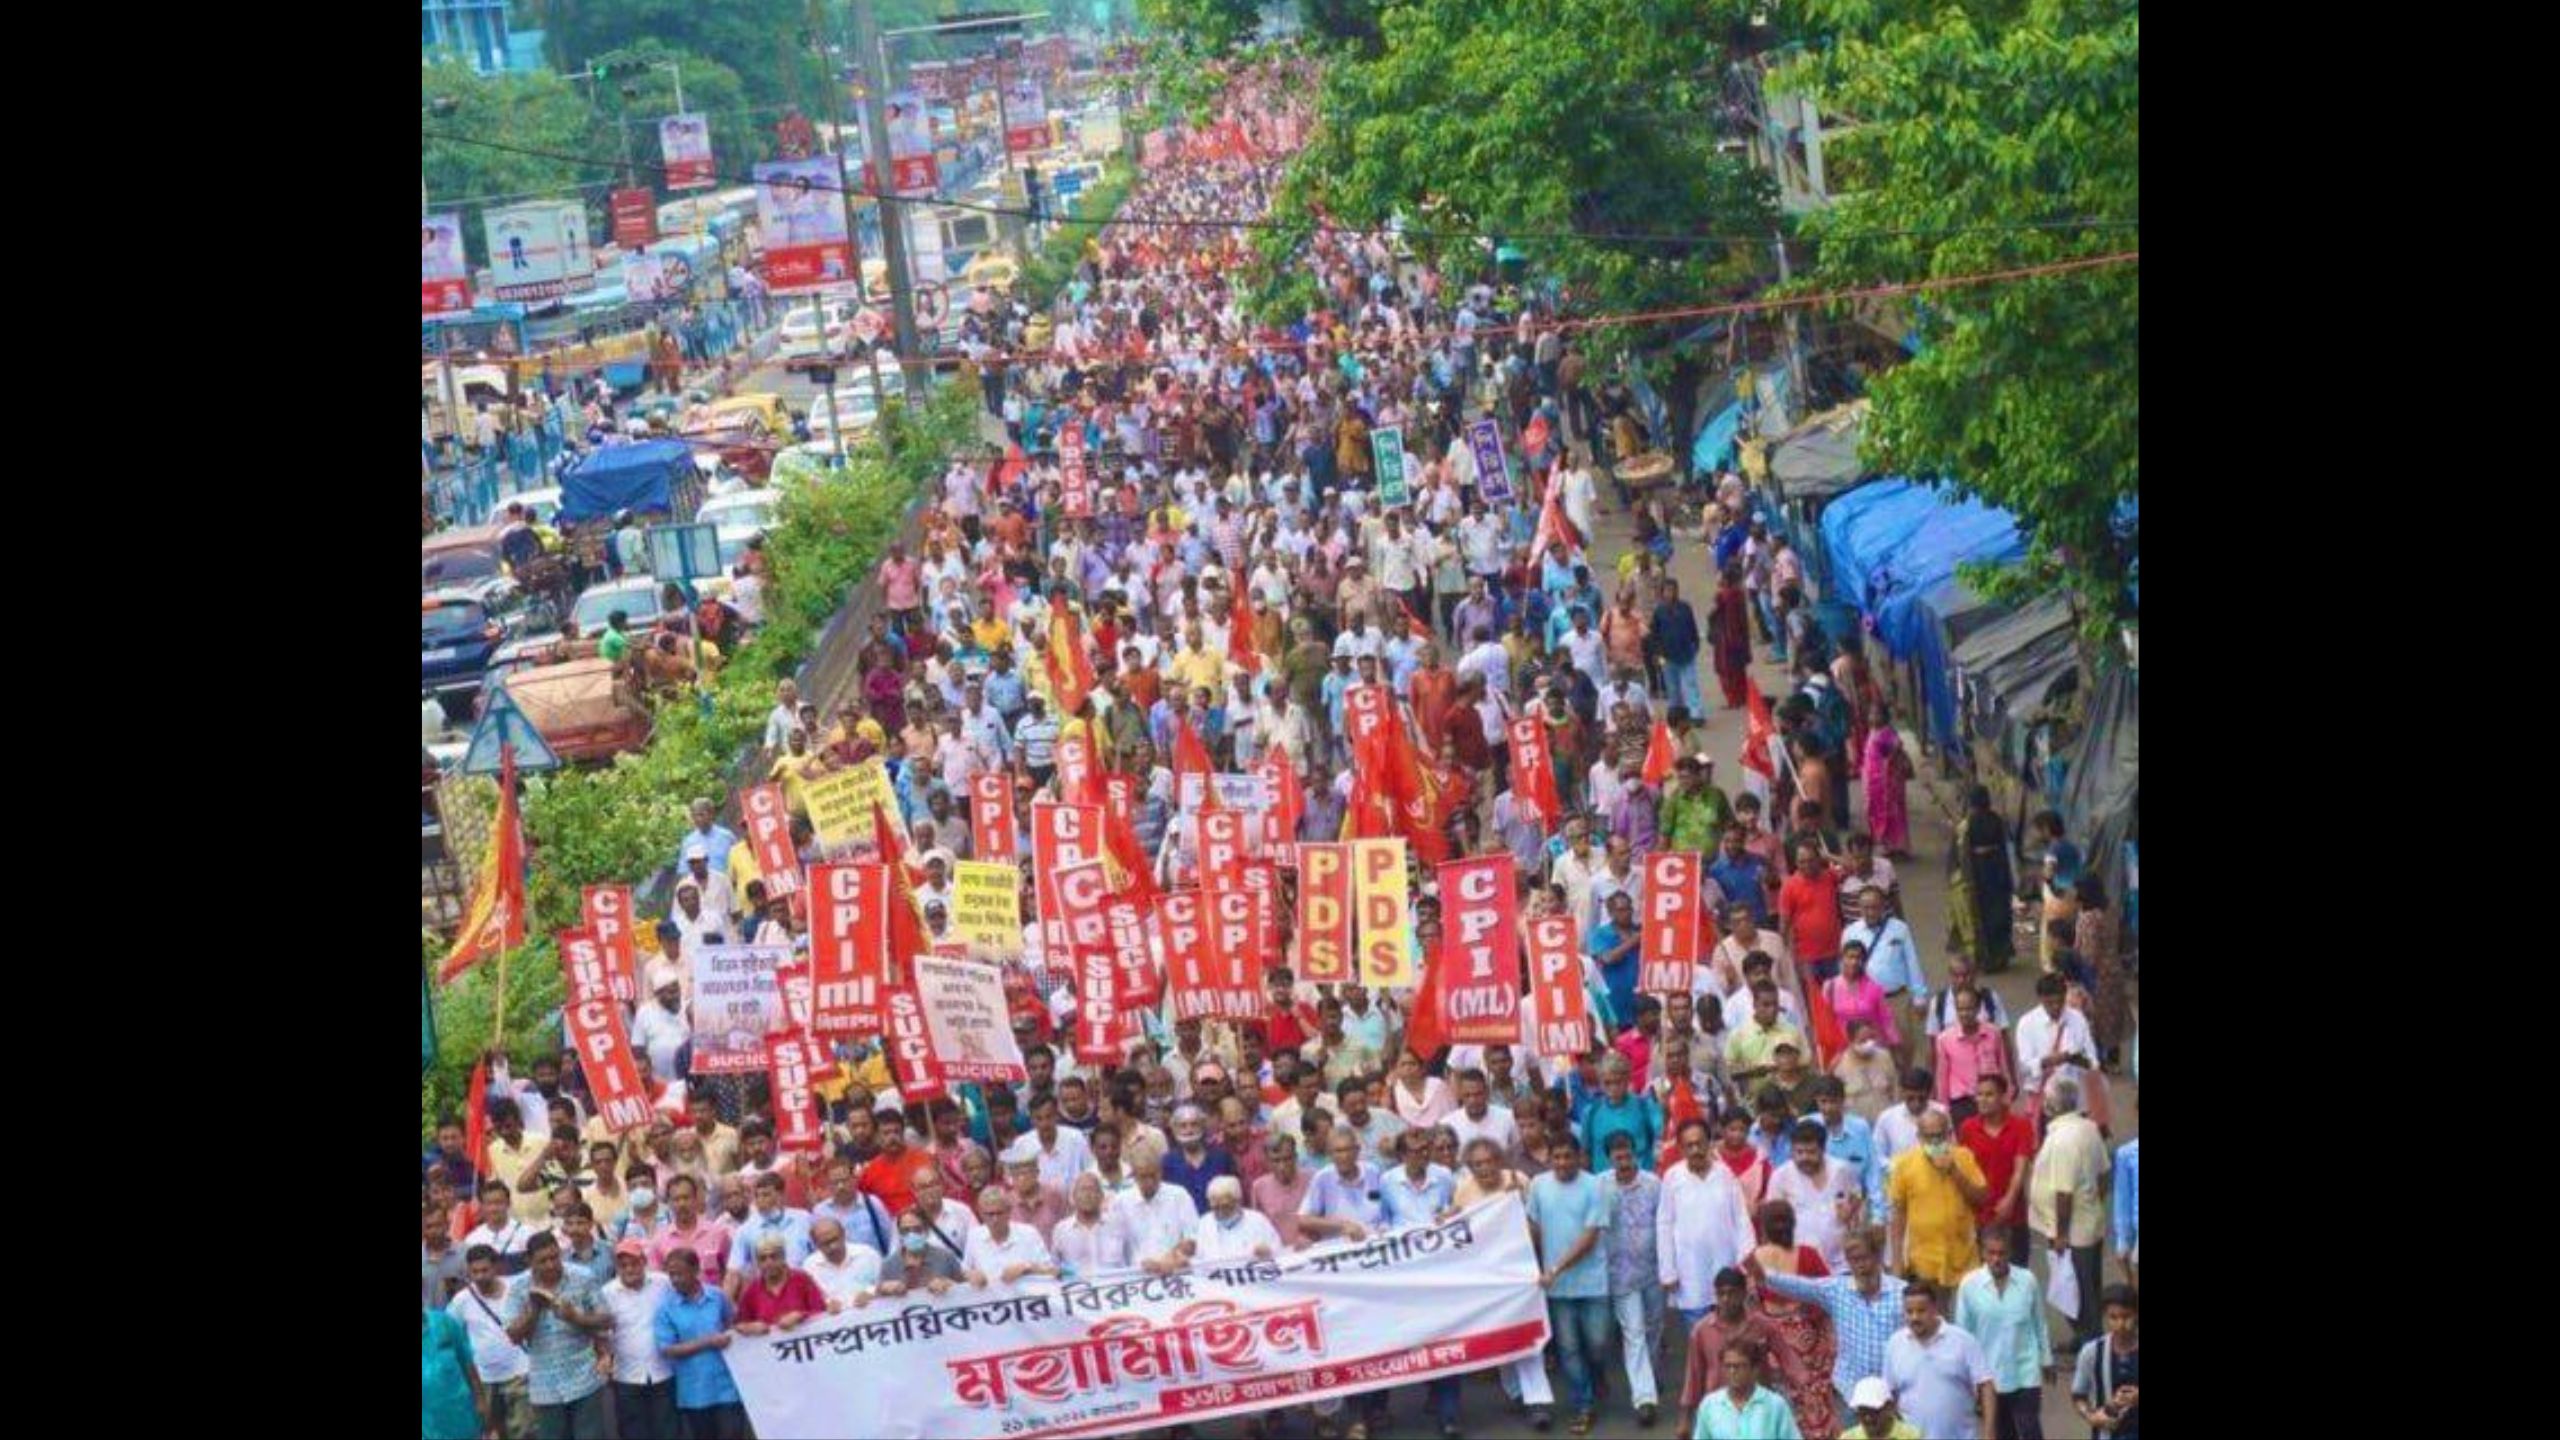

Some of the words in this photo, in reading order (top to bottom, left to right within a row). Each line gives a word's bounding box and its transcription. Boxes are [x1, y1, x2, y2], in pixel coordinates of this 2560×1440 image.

[1308, 849, 1340, 975] PDS
[1368, 848, 1398, 977] PDS
[771, 1295, 1051, 1364] সাম্প্রদায়িকতার
[1061, 1274, 1196, 1316] বিরুদ্ধে
[947, 1300, 1323, 1408] মহামিছিল
